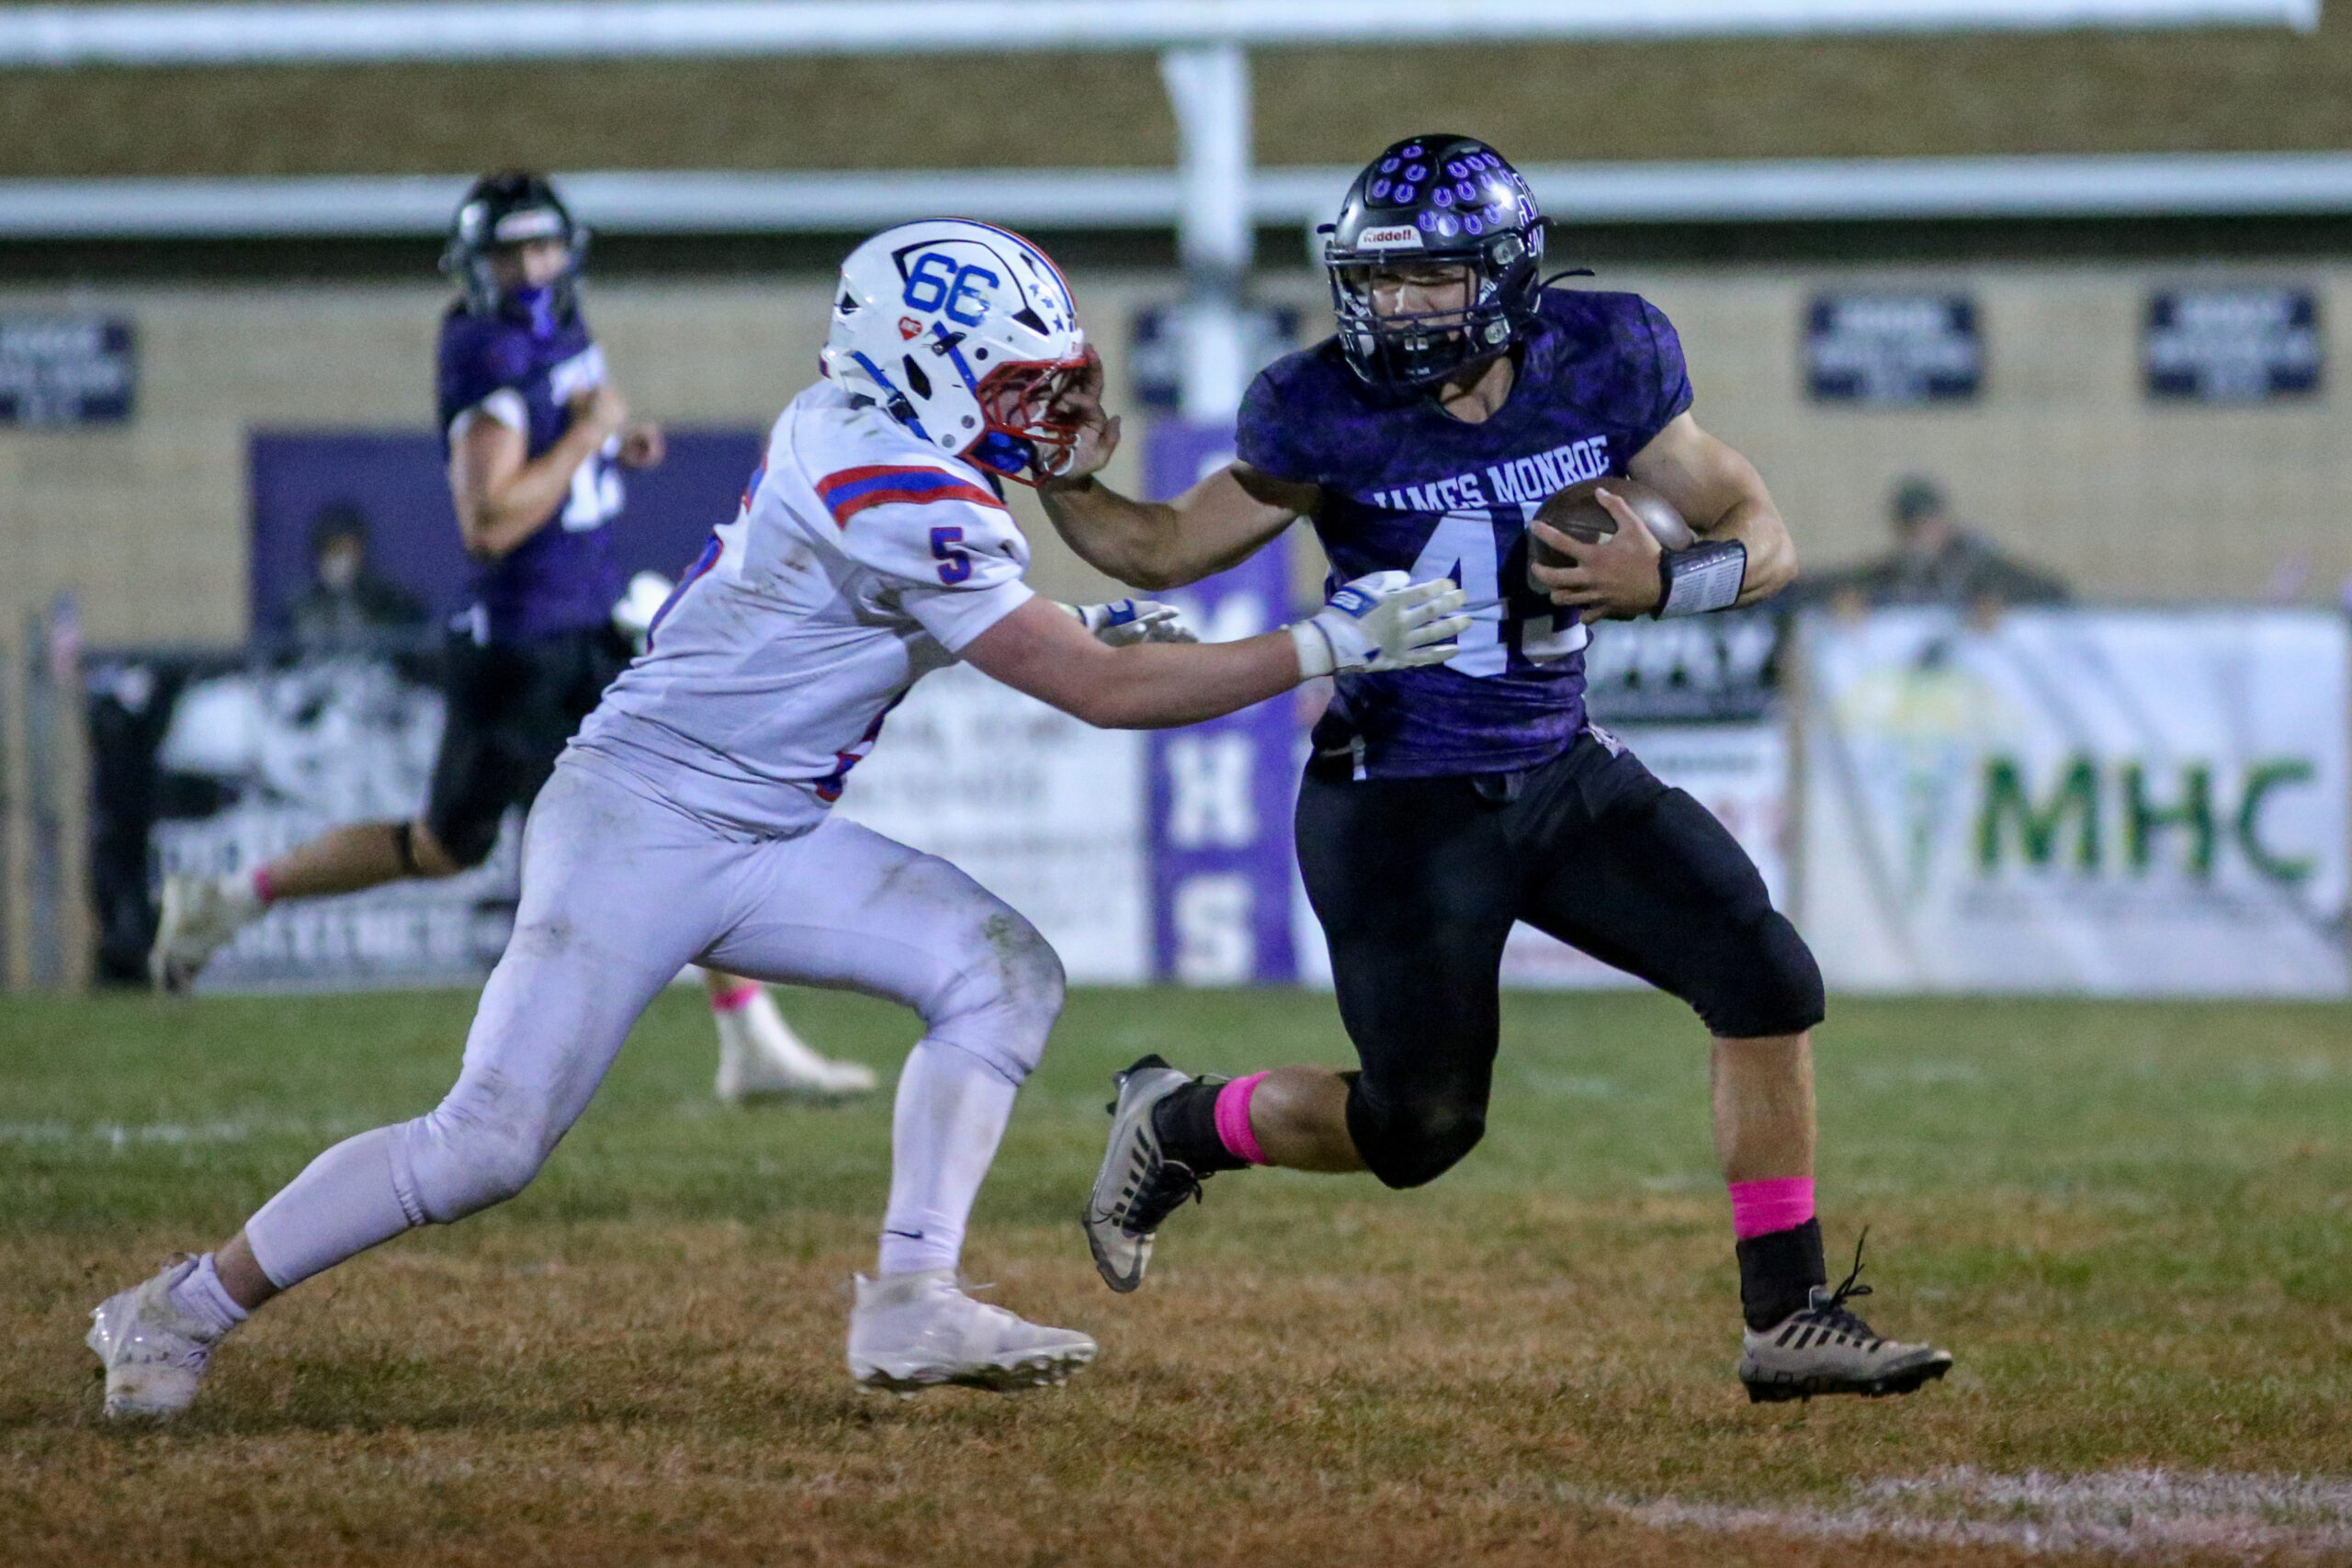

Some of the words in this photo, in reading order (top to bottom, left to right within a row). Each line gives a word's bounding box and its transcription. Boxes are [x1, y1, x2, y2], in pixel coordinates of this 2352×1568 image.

[1487, 434, 1610, 503] MONROE
[931, 526, 971, 585] 5
[1975, 749, 2316, 884] MHC
